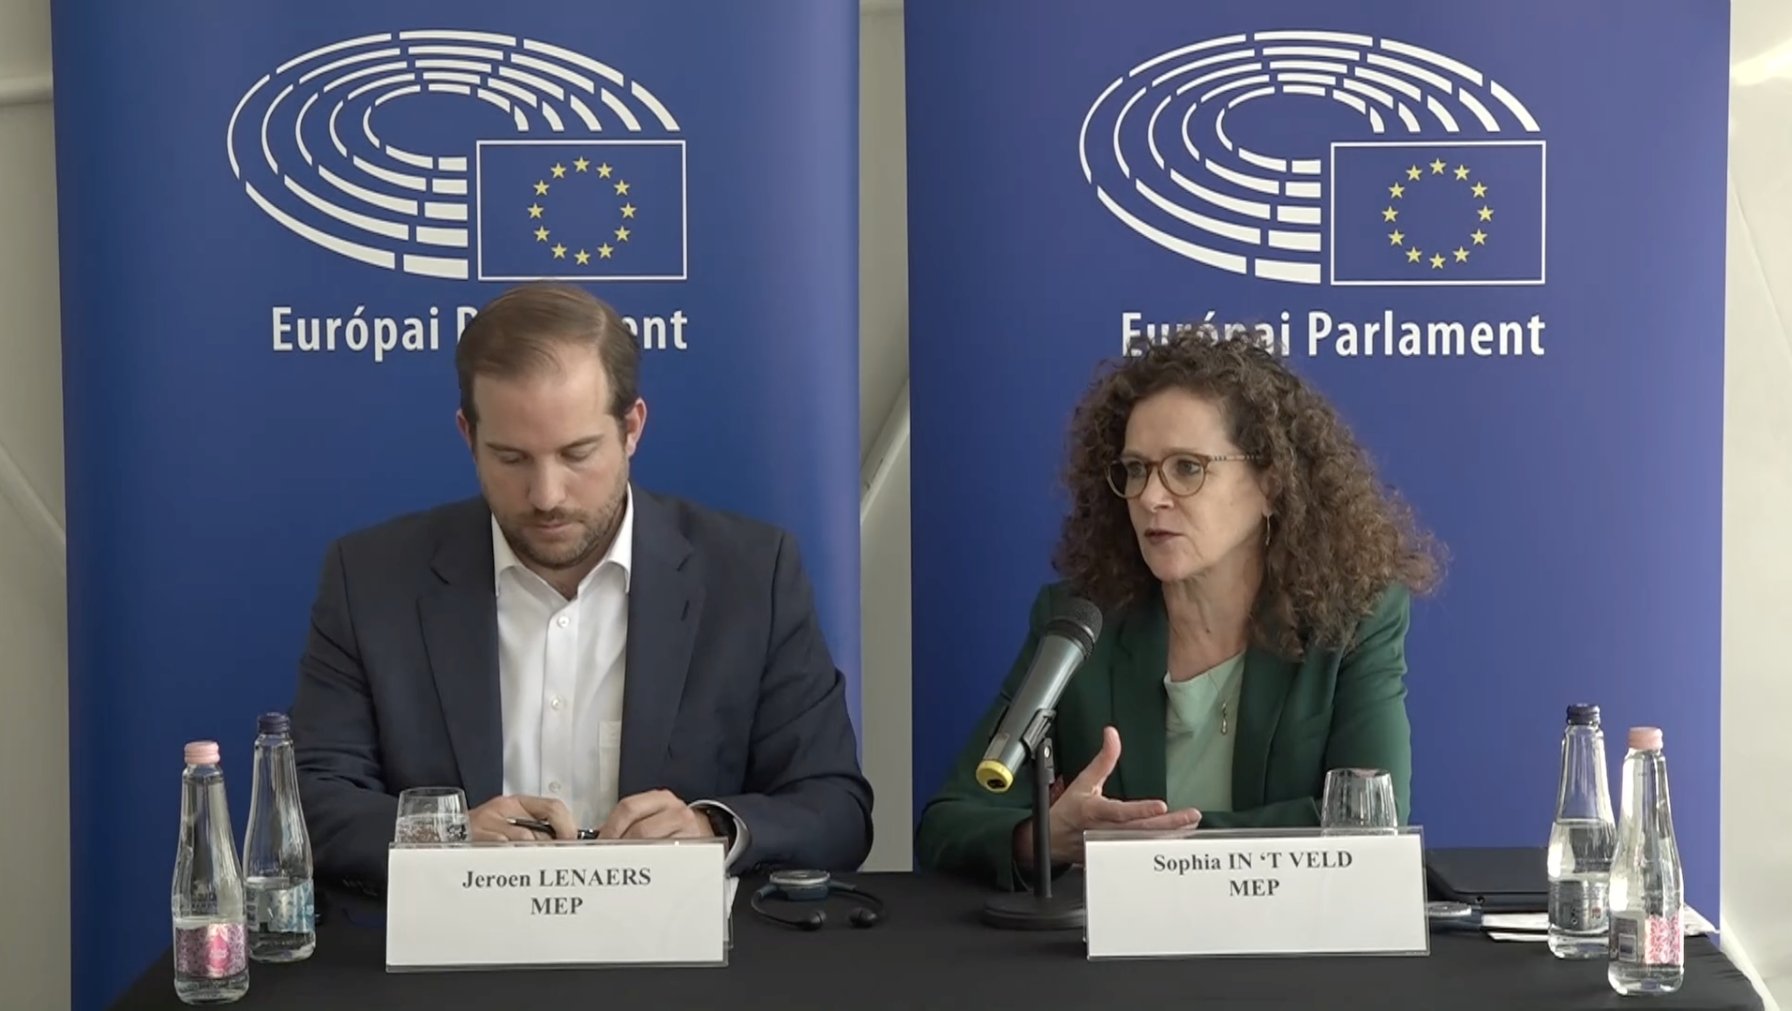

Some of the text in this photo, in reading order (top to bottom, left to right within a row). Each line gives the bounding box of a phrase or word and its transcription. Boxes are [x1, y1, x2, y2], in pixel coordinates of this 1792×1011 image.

[272, 305, 439, 362] Európai
[1308, 310, 1546, 357] Parlament
[1153, 853, 1221, 876] Sophia
[1228, 853, 1252, 870] IN
[1289, 851, 1353, 868] VELD
[462, 868, 651, 888] Jeroen LENAERS
[1229, 879, 1280, 897] MEP
[530, 897, 584, 915] MEP
